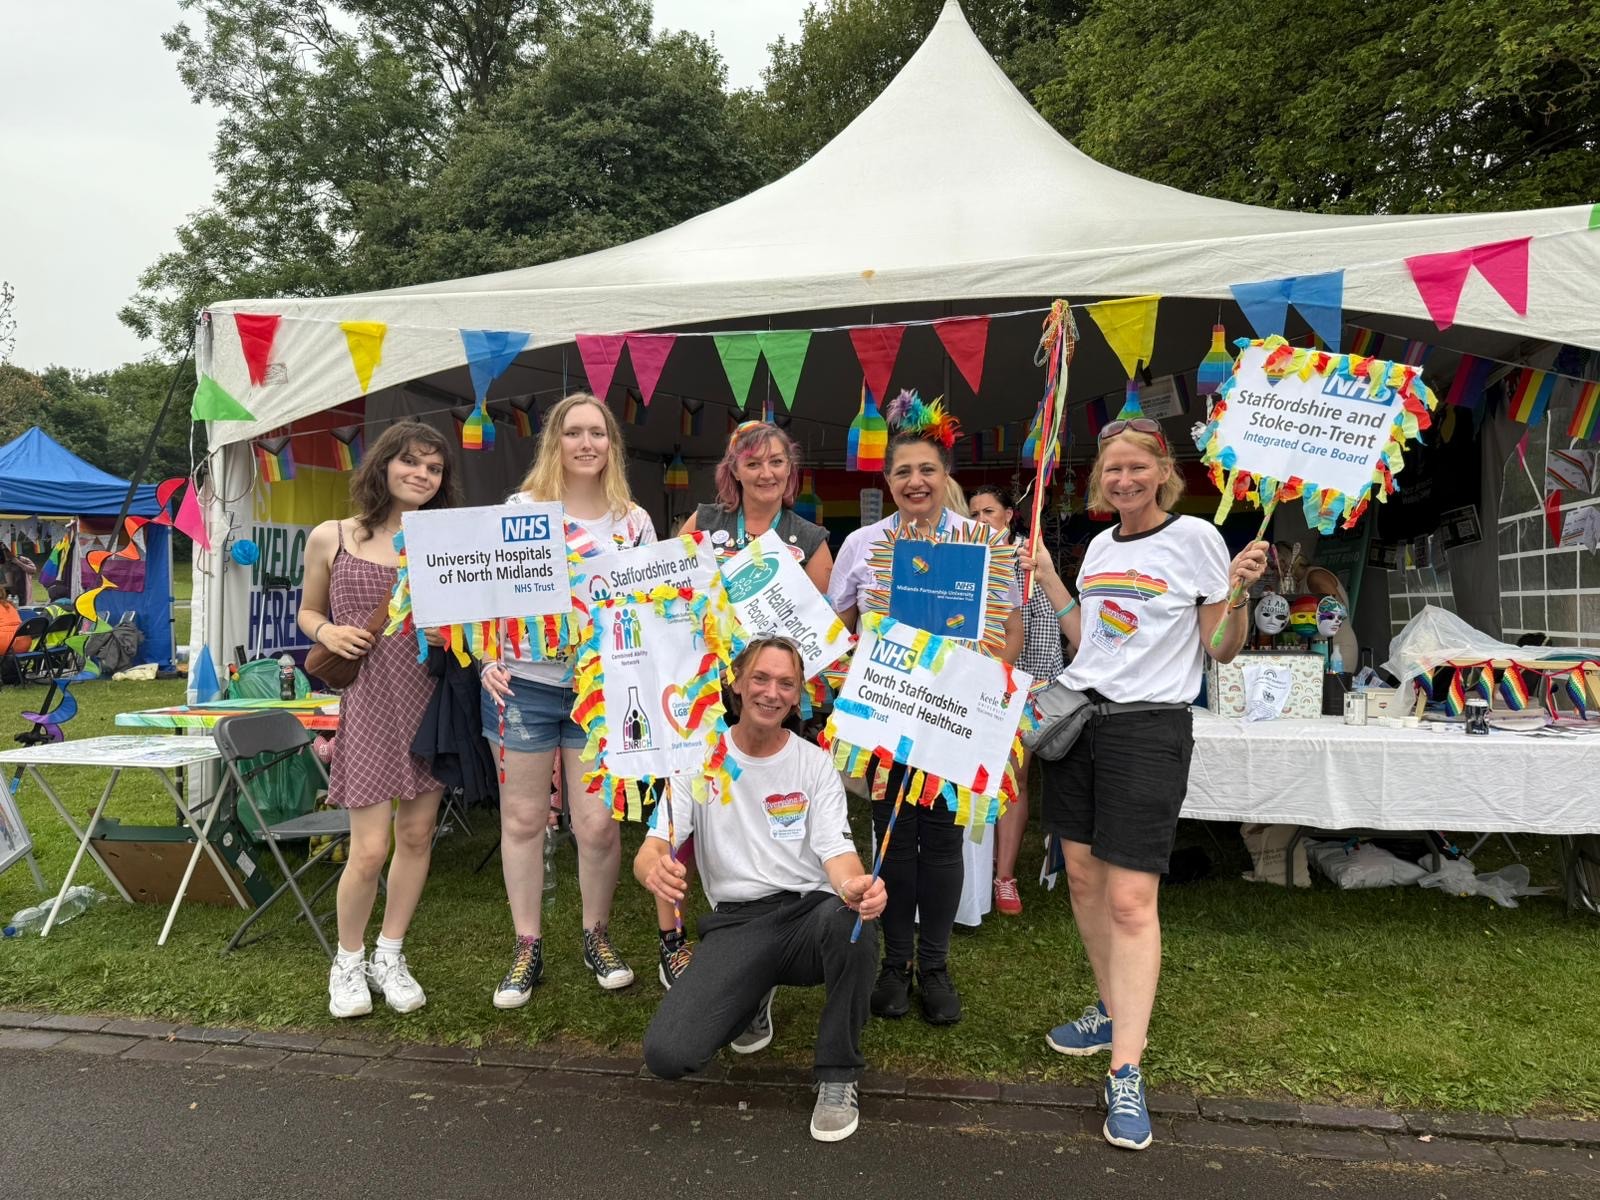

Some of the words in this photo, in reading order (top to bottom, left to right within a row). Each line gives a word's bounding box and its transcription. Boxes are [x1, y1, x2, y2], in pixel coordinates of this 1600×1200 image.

[1237, 389, 1343, 421] Staffordshire
[1346, 411, 1386, 429] and
[1249, 411, 1377, 449] Stoke-on-Trent
[1243, 431, 1299, 450] Integrated
[1301, 440, 1328, 457] Care
[1330, 449, 1369, 465] Board
[504, 516, 547, 541] NHS
[252, 526, 306, 586] WELC
[426, 552, 491, 567] University
[495, 546, 551, 564] Hospitals
[610, 559, 677, 588] Staffordshire
[679, 554, 699, 571] and
[439, 570, 454, 584] of
[457, 567, 493, 583] North
[496, 563, 553, 580] Midlands
[514, 584, 532, 593] NHS
[535, 582, 555, 592] Trust
[956, 582, 974, 590] NHS
[896, 585, 918, 593] Midlands
[920, 588, 947, 596] Partnership
[948, 591, 974, 599] University
[744, 598, 769, 630] People
[763, 583, 796, 621] Health
[785, 615, 812, 639] and
[801, 632, 822, 661] Care
[872, 640, 917, 670] NHS
[864, 667, 897, 690] North
[898, 680, 968, 718] Staffordshire
[980, 692, 1000, 706] Keele
[853, 702, 870, 715] NHS
[870, 709, 889, 724] Trust
[858, 685, 916, 716] Combined
[916, 706, 973, 740] Healthcare
[624, 740, 652, 750] ENRICH
